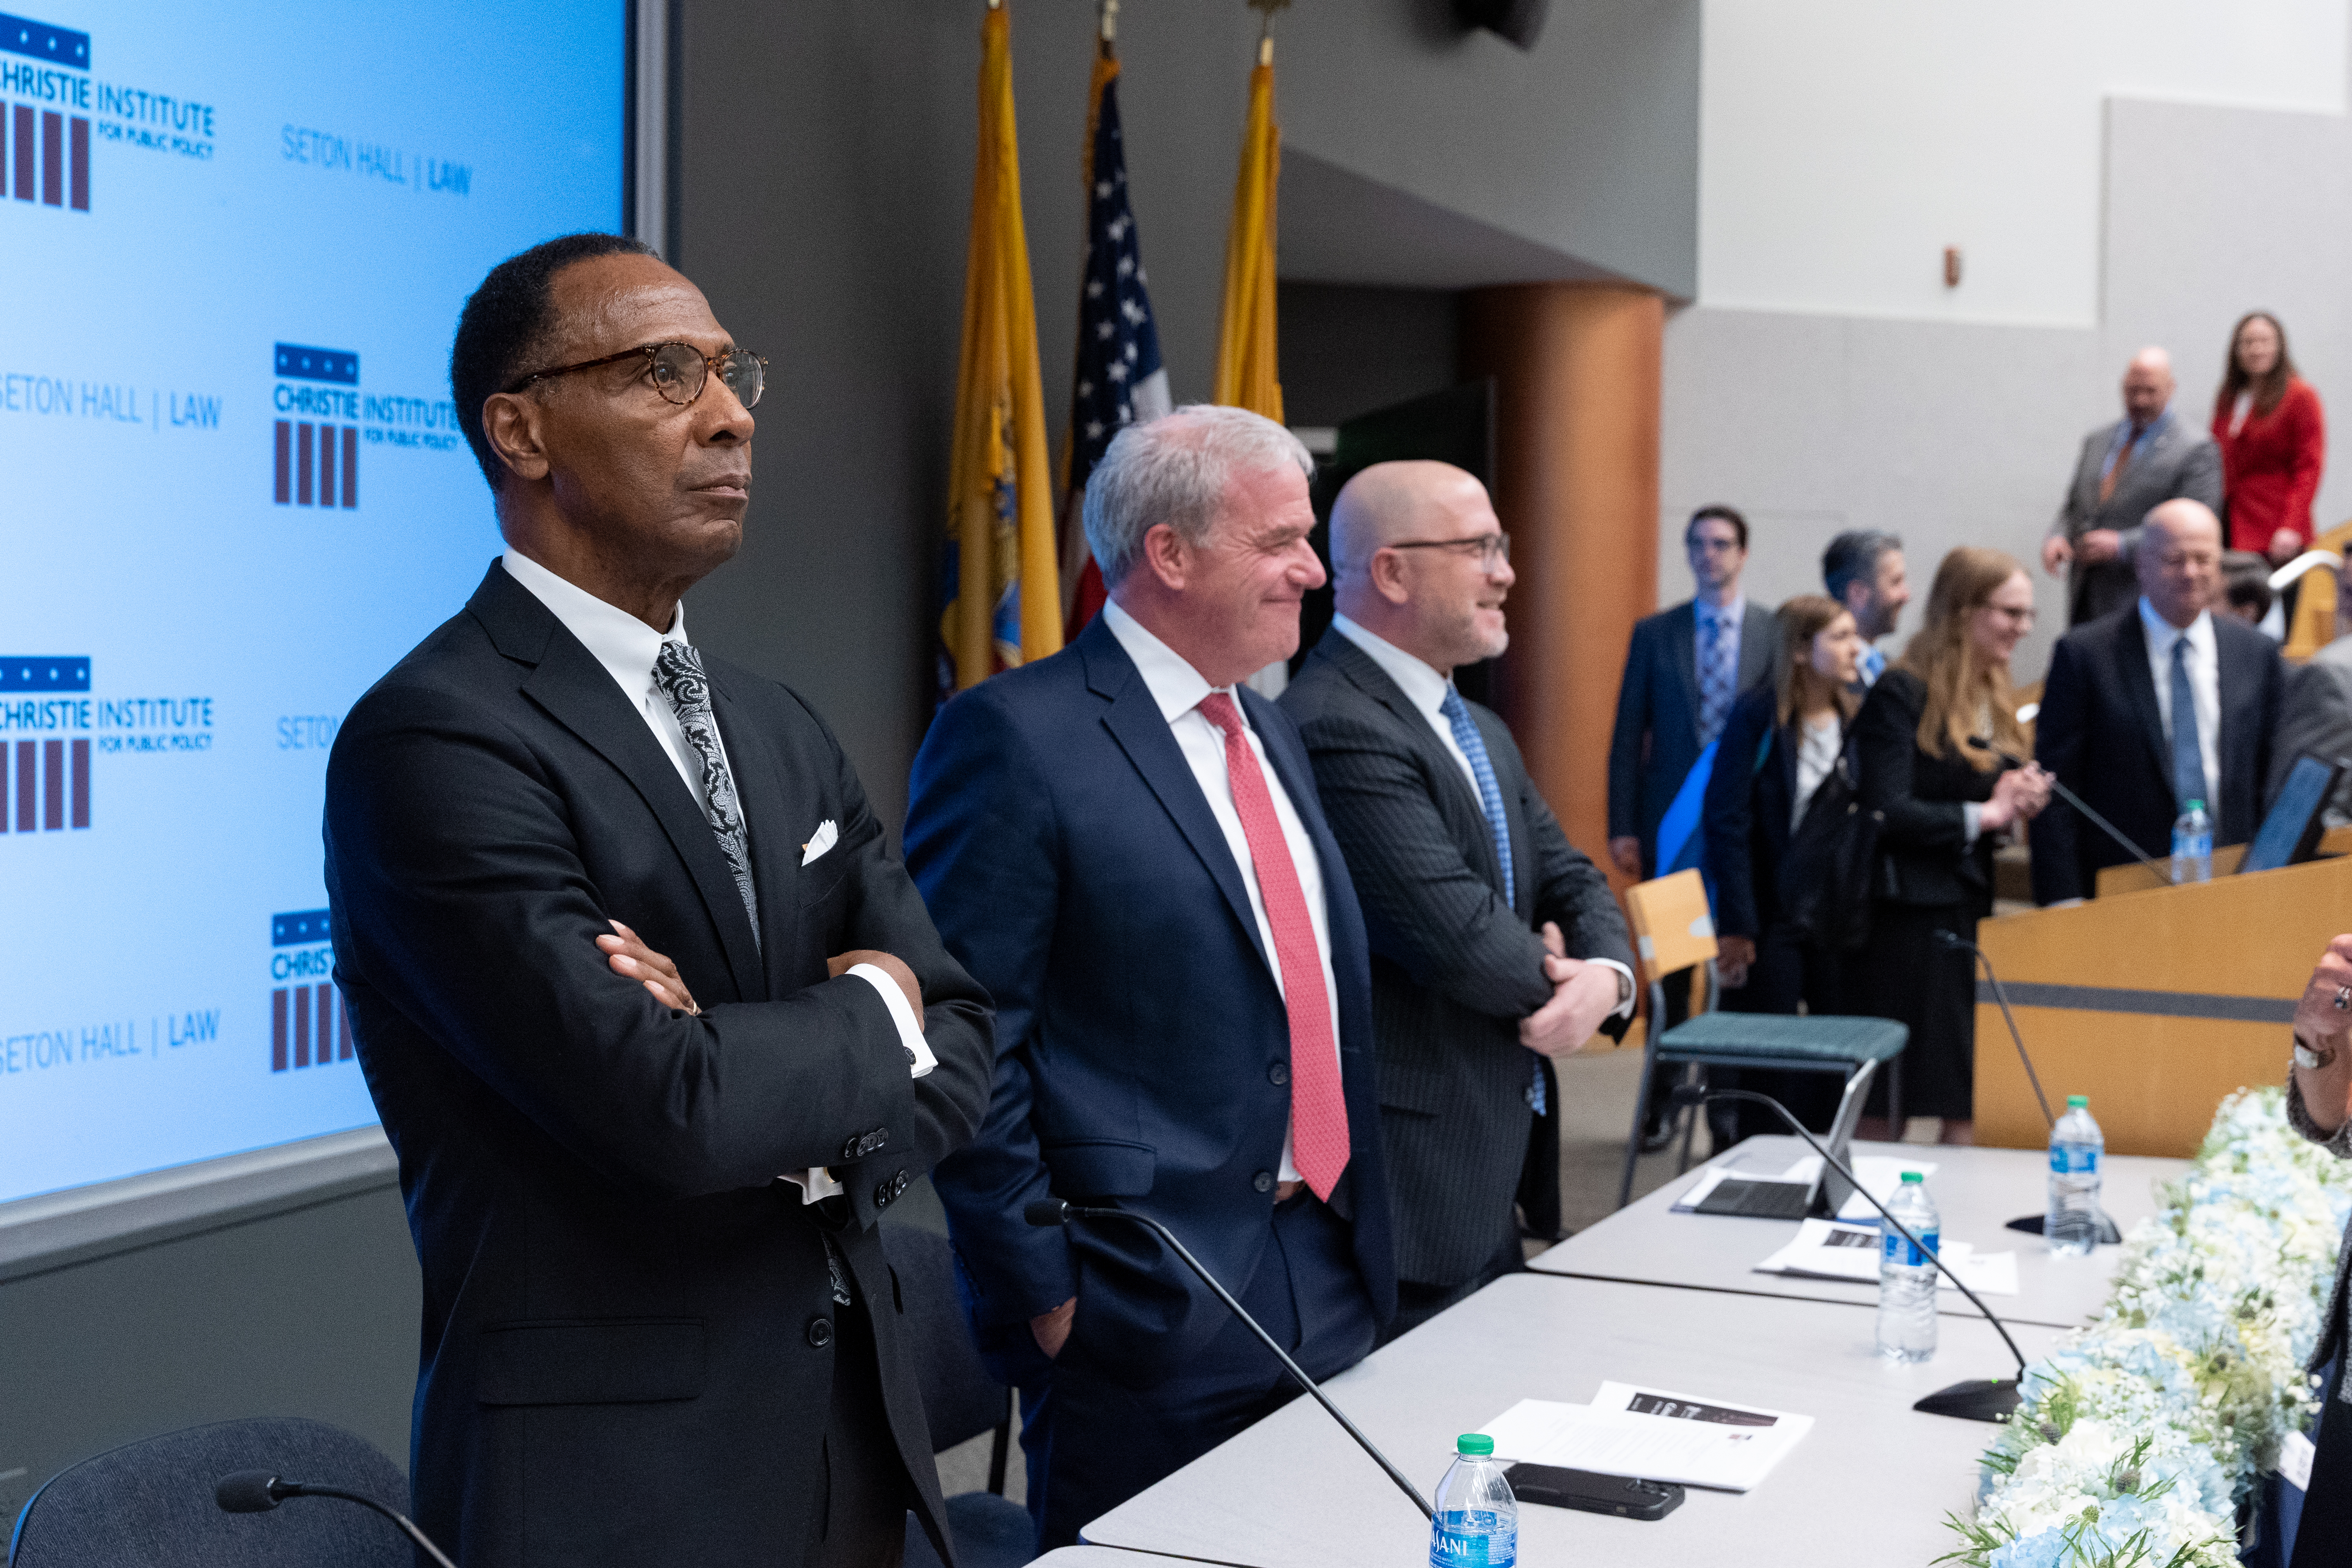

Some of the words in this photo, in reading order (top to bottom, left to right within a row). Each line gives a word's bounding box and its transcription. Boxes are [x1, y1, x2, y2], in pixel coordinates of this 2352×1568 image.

[0, 61, 90, 109] HRISTIE
[98, 81, 214, 137] INSTITUTE
[98, 119, 122, 139] FOR
[127, 127, 167, 151] PUBLIC
[171, 137, 213, 160] POLICY
[281, 125, 352, 172] SETON
[357, 142, 406, 185] HALL
[428, 156, 473, 196] LAW
[81, 380, 142, 424] HALL
[170, 390, 223, 430] LAW
[274, 383, 358, 420] CHRISTIE
[364, 428, 384, 442] FOR
[387, 430, 421, 448] PUBLIC
[0, 700, 90, 729] HRISTIE
[98, 698, 213, 729] INSTITUTE
[98, 735, 122, 753] FOR
[128, 735, 167, 752] PUBLIC
[172, 734, 213, 750] POLICY
[81, 1019, 142, 1062] HALL
[168, 1006, 222, 1048] LAW
[1431, 1530, 1467, 1556] ASANI
